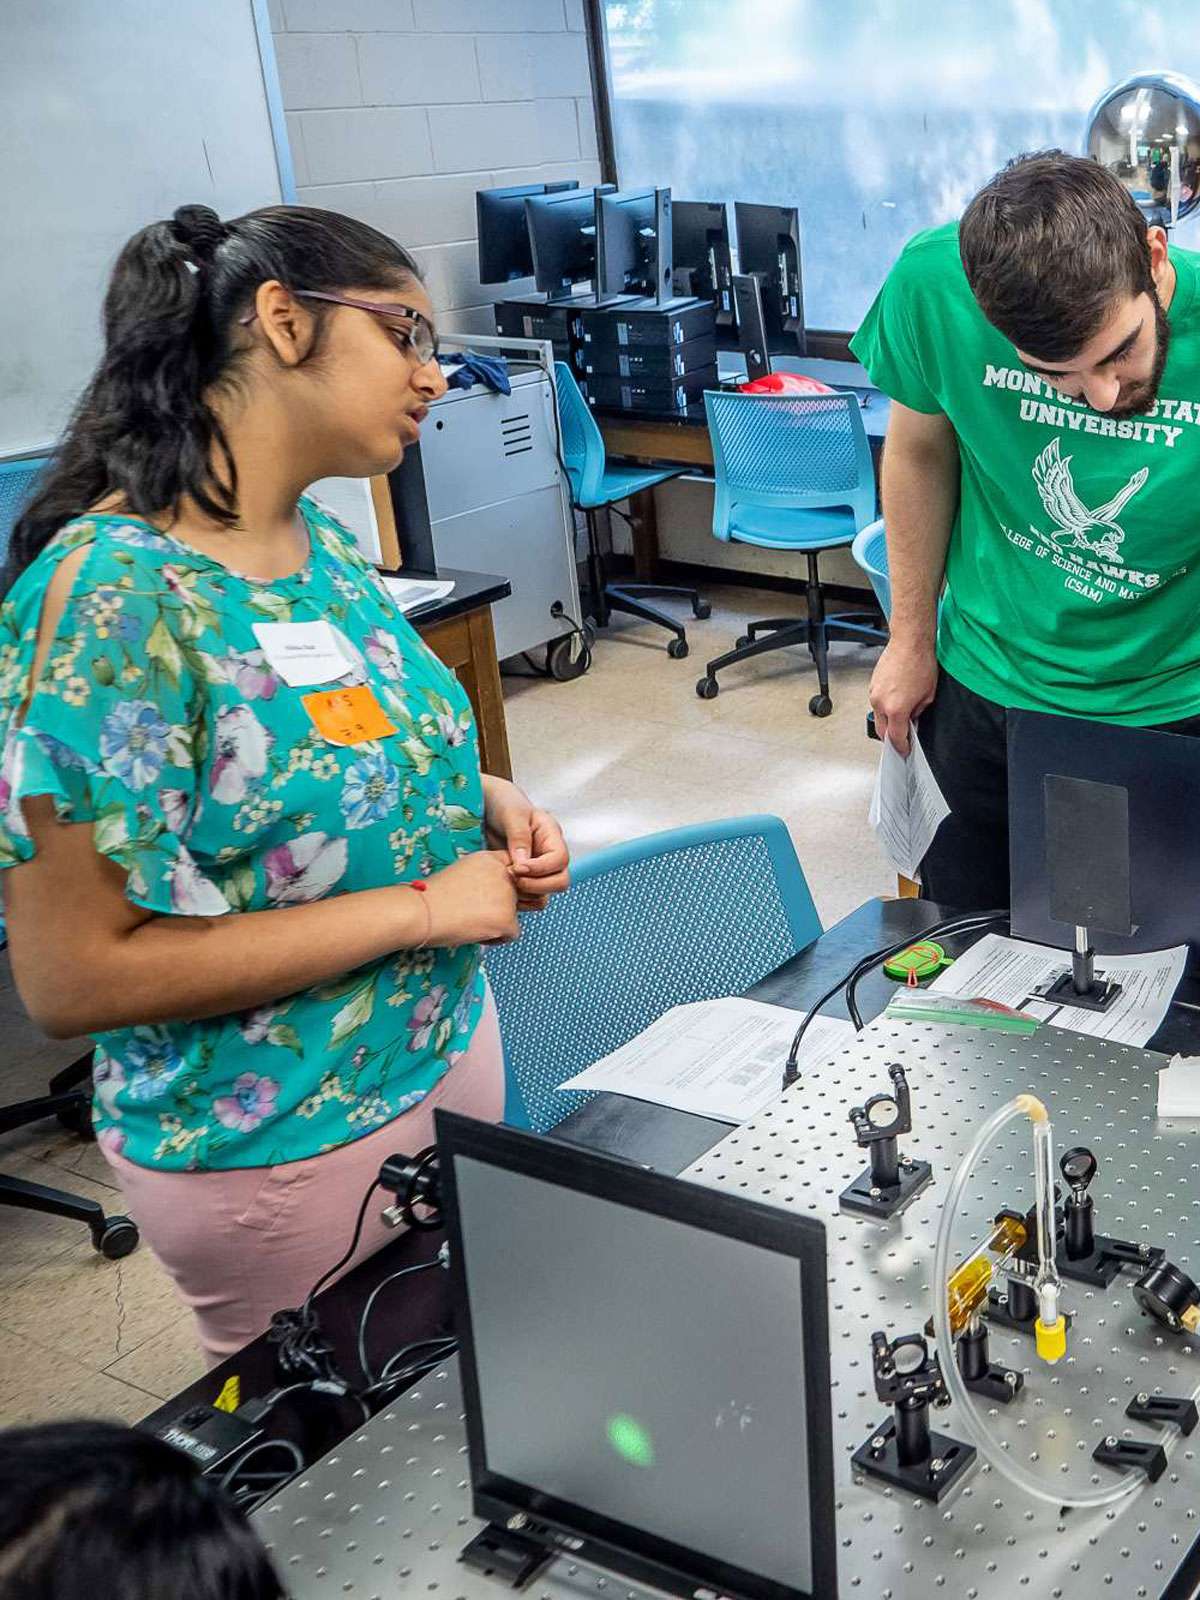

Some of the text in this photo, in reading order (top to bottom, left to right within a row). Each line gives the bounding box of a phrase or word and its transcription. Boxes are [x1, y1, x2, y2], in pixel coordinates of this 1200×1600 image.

[1019, 398, 1183, 447] UNIVERSITY
[1035, 543, 1050, 558] OF
[1051, 553, 1093, 581] SCIENCE
[1094, 576, 1117, 594] AND
[1064, 575, 1104, 604] (CSAM)
